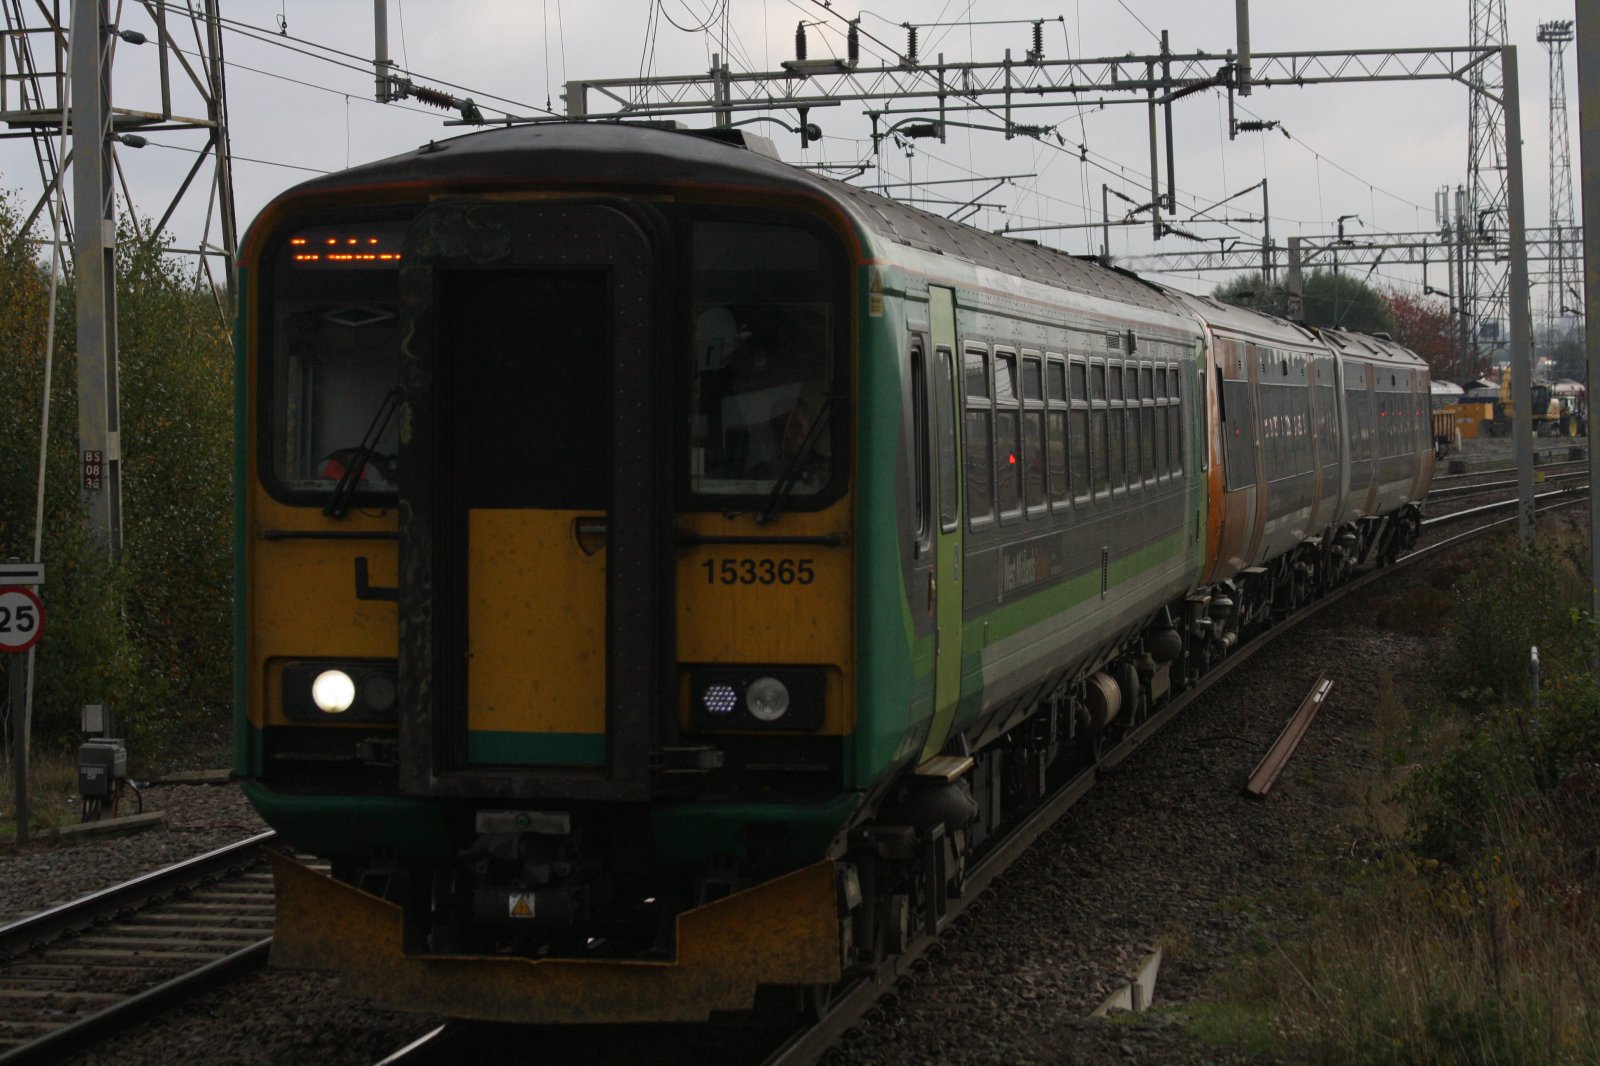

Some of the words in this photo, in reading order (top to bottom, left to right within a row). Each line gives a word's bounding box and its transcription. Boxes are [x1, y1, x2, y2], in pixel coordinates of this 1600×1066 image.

[85, 451, 100, 462] BS
[85, 465, 100, 476] 08
[702, 558, 815, 585] 153365
[0, 605, 35, 632] 25
